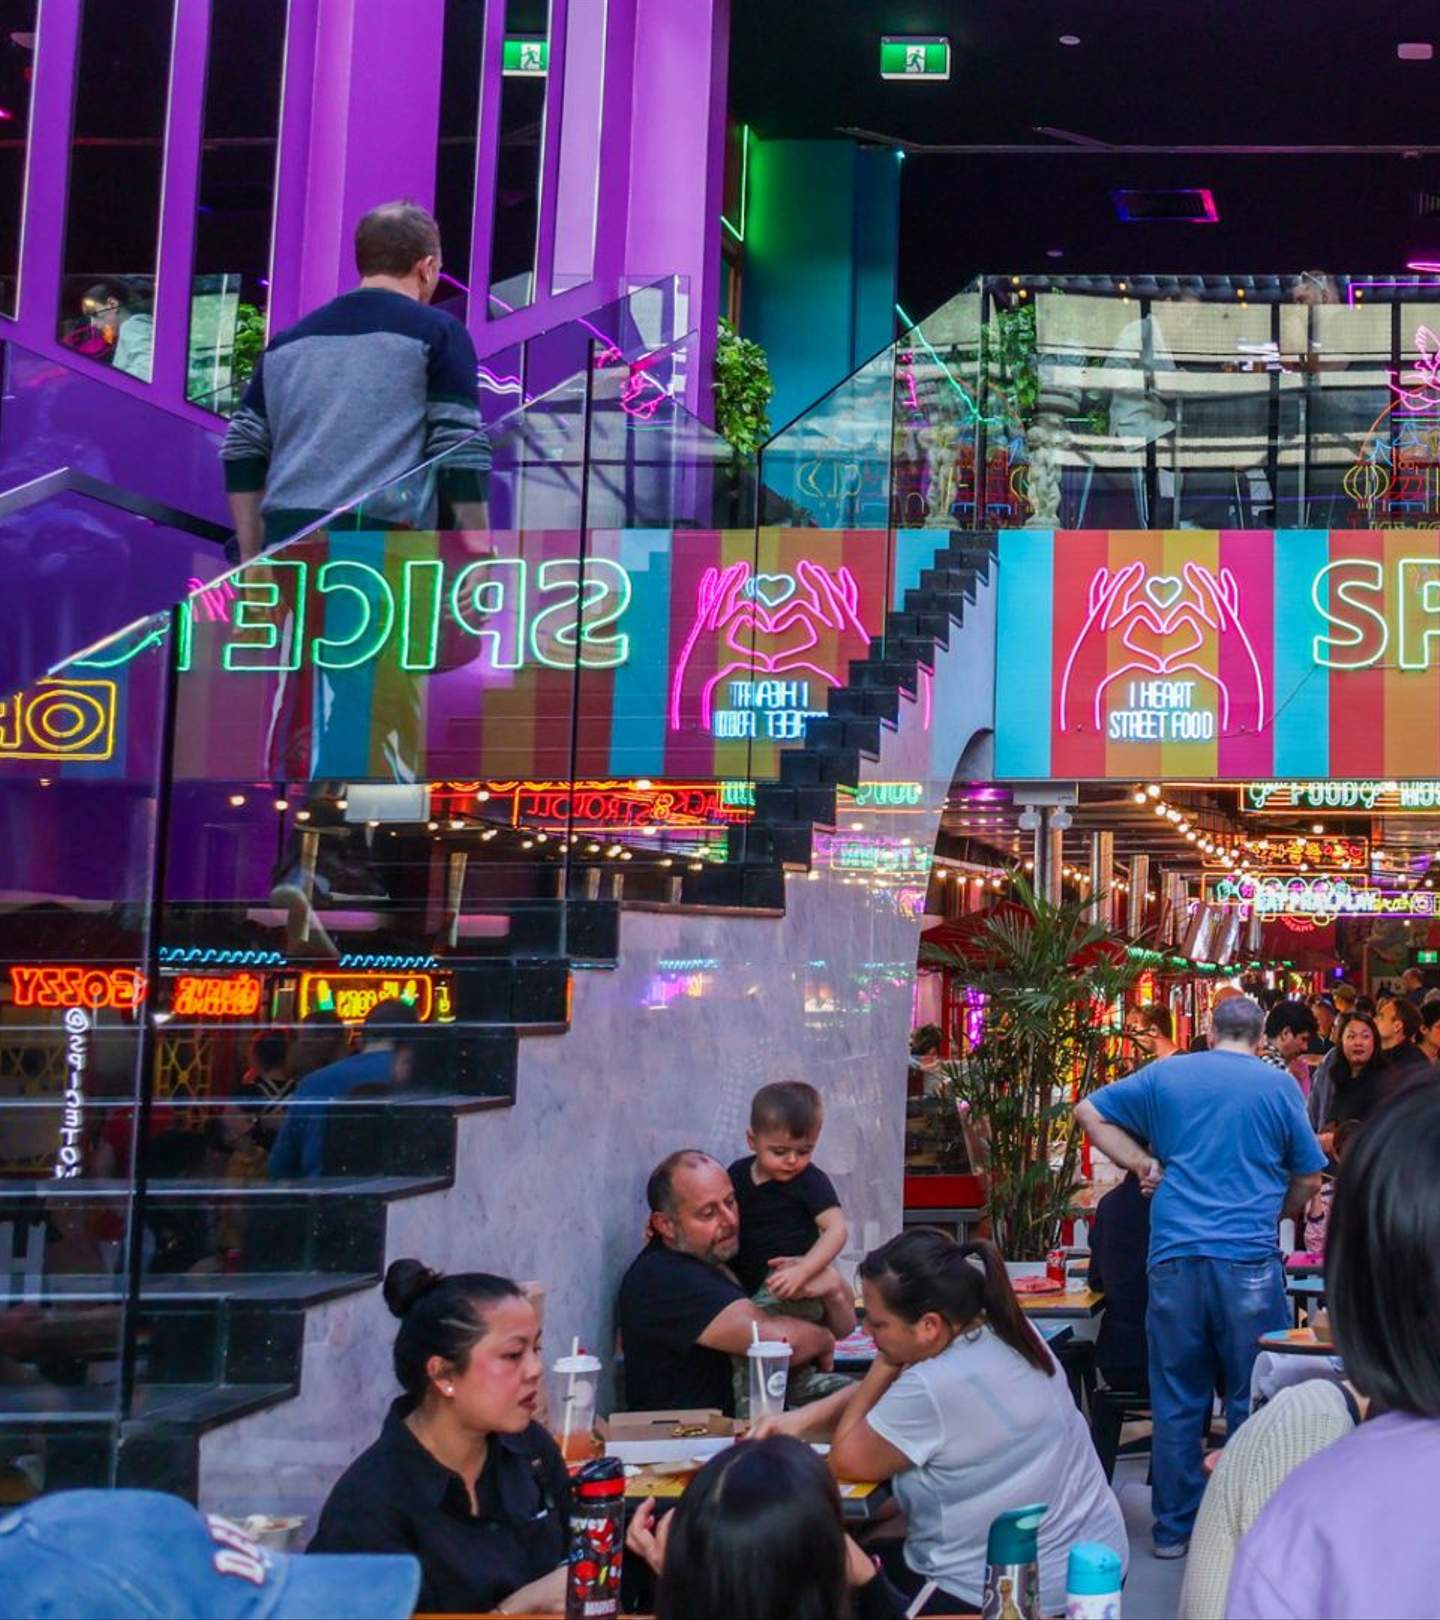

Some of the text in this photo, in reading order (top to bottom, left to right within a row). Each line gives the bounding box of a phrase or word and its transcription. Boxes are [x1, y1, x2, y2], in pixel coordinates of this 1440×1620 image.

[1129, 681, 1195, 709] I HEART
[1109, 711, 1213, 739] STREET FOOD
